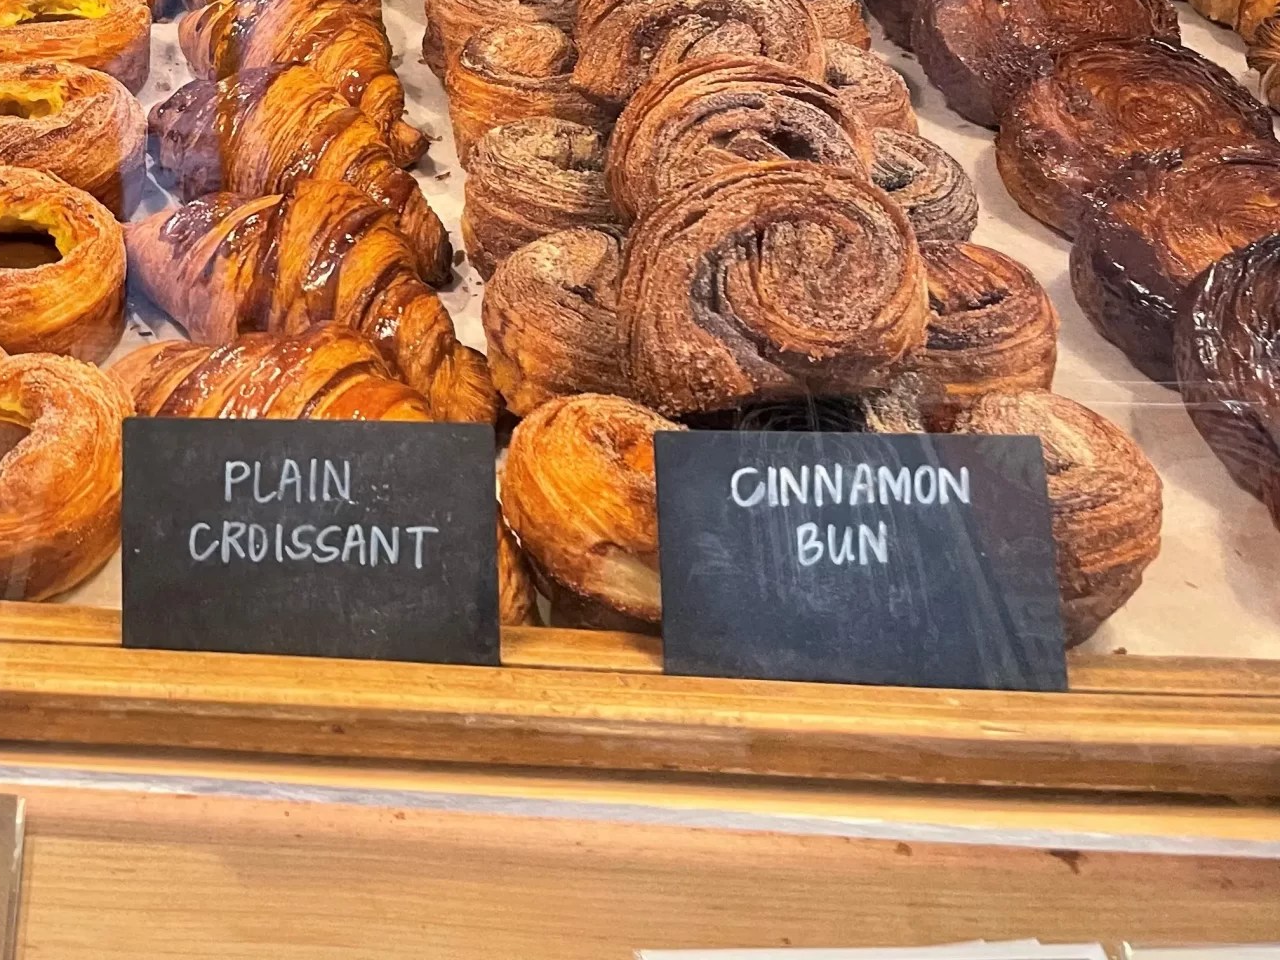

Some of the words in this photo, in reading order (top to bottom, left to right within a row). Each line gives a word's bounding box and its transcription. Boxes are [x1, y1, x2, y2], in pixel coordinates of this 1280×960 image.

[224, 458, 351, 503] PLAIN
[730, 462, 970, 508] CINNAMON
[189, 521, 440, 569] CROISSANT
[796, 521, 888, 566] BUN
